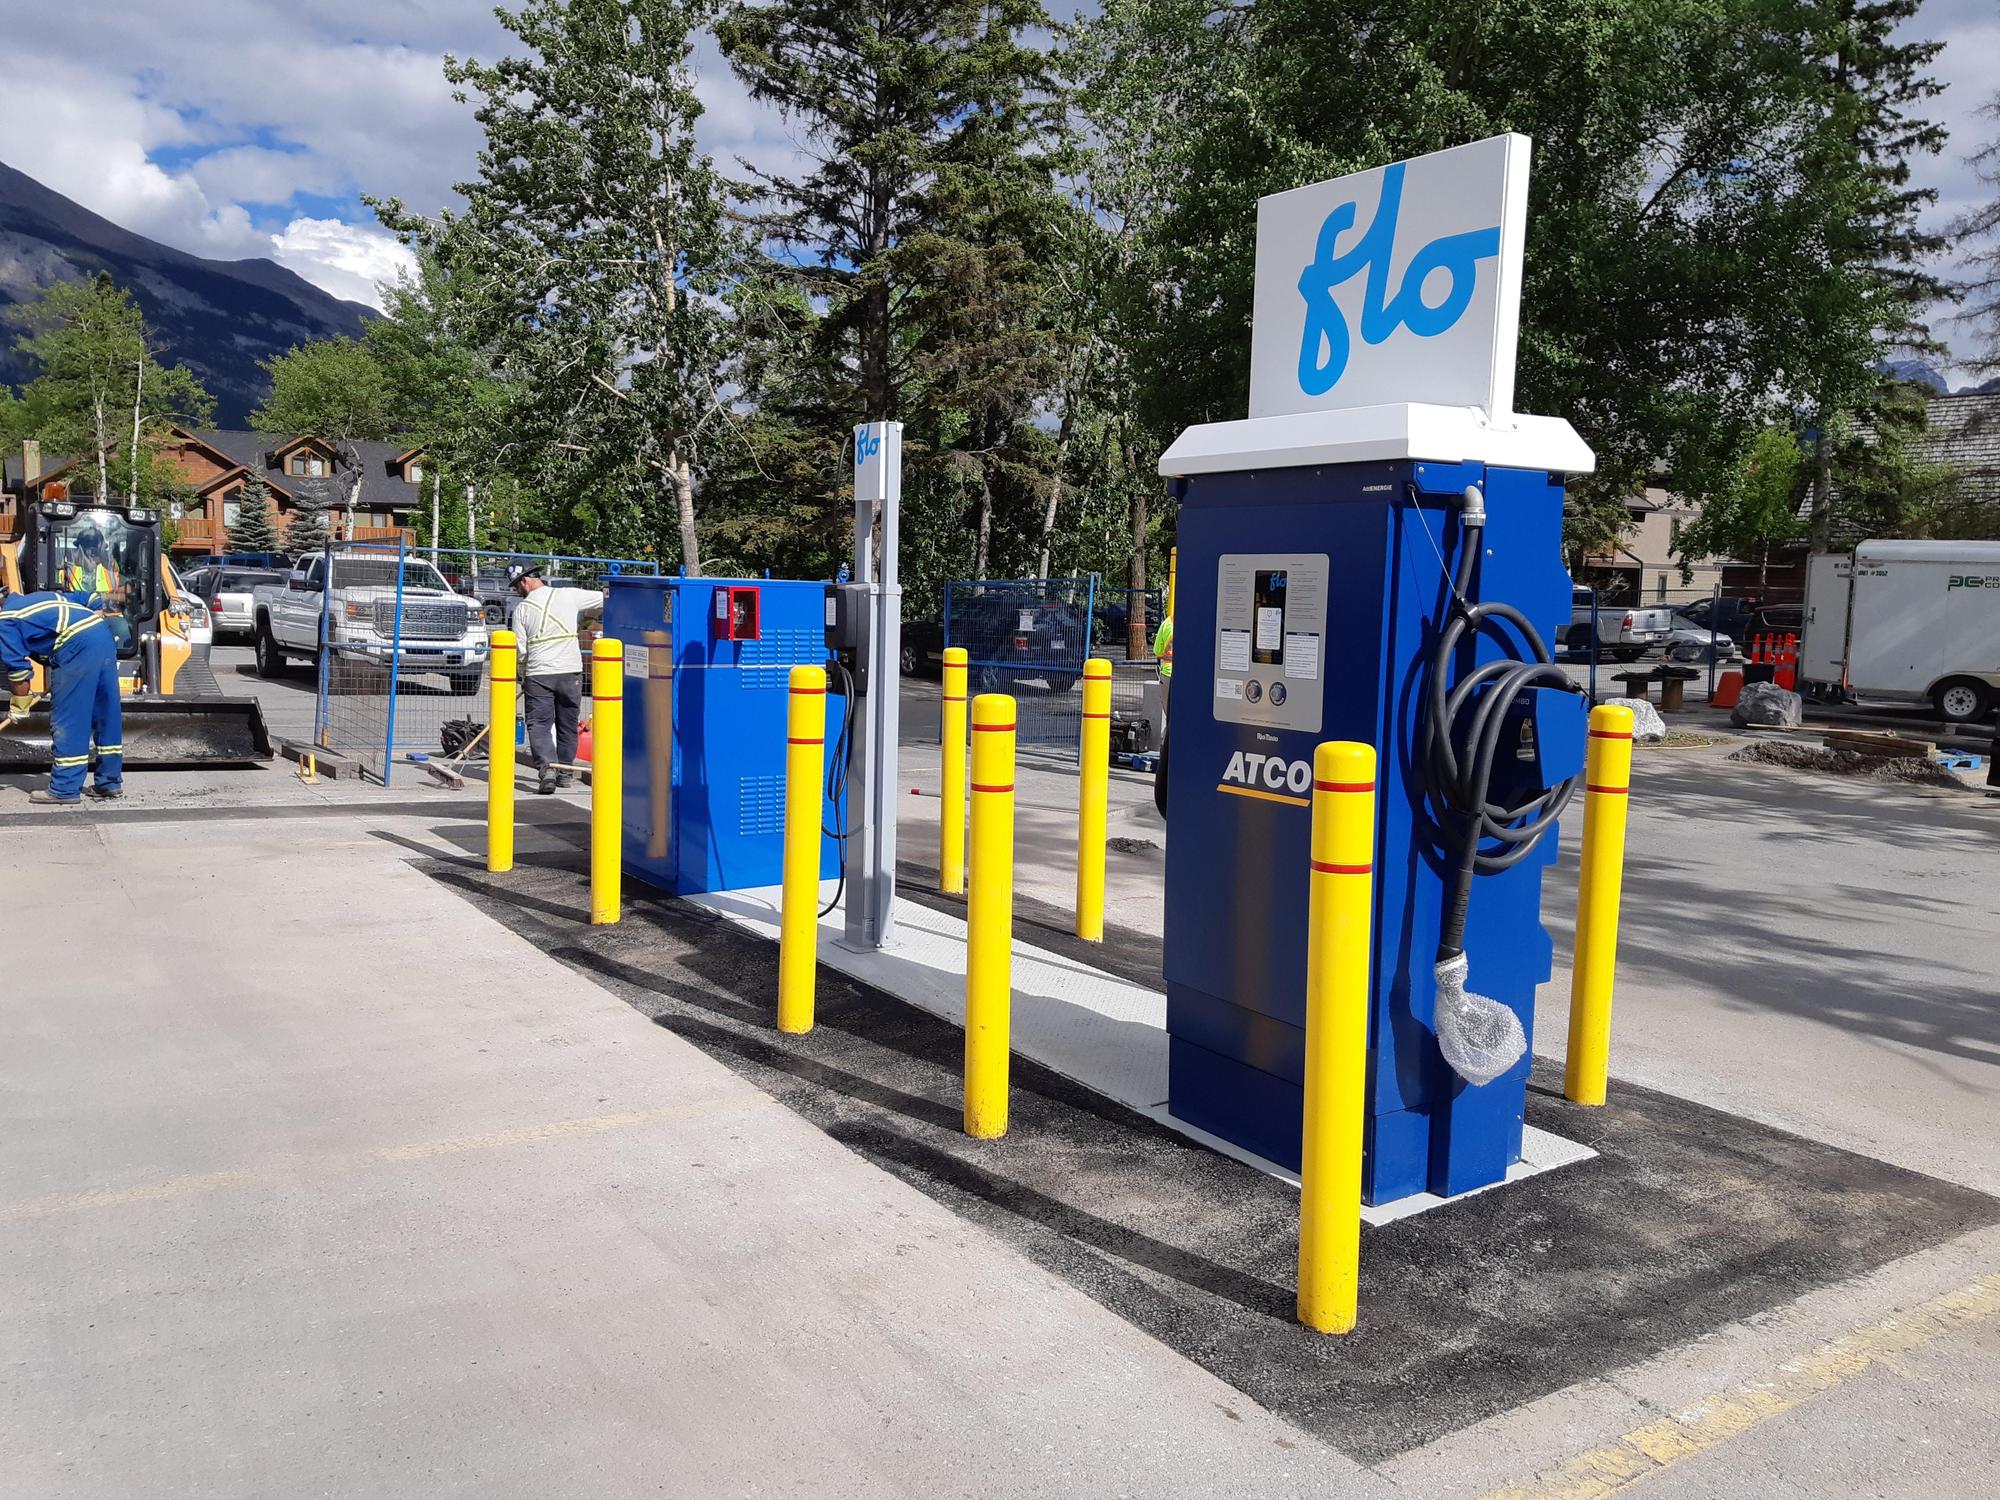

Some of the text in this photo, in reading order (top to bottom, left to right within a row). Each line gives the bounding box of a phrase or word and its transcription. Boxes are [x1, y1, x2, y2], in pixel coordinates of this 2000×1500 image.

[1298, 162, 1500, 396] flo
[857, 424, 880, 465] flo
[1270, 572, 1288, 591] flo
[1222, 751, 1312, 793] ATCO
